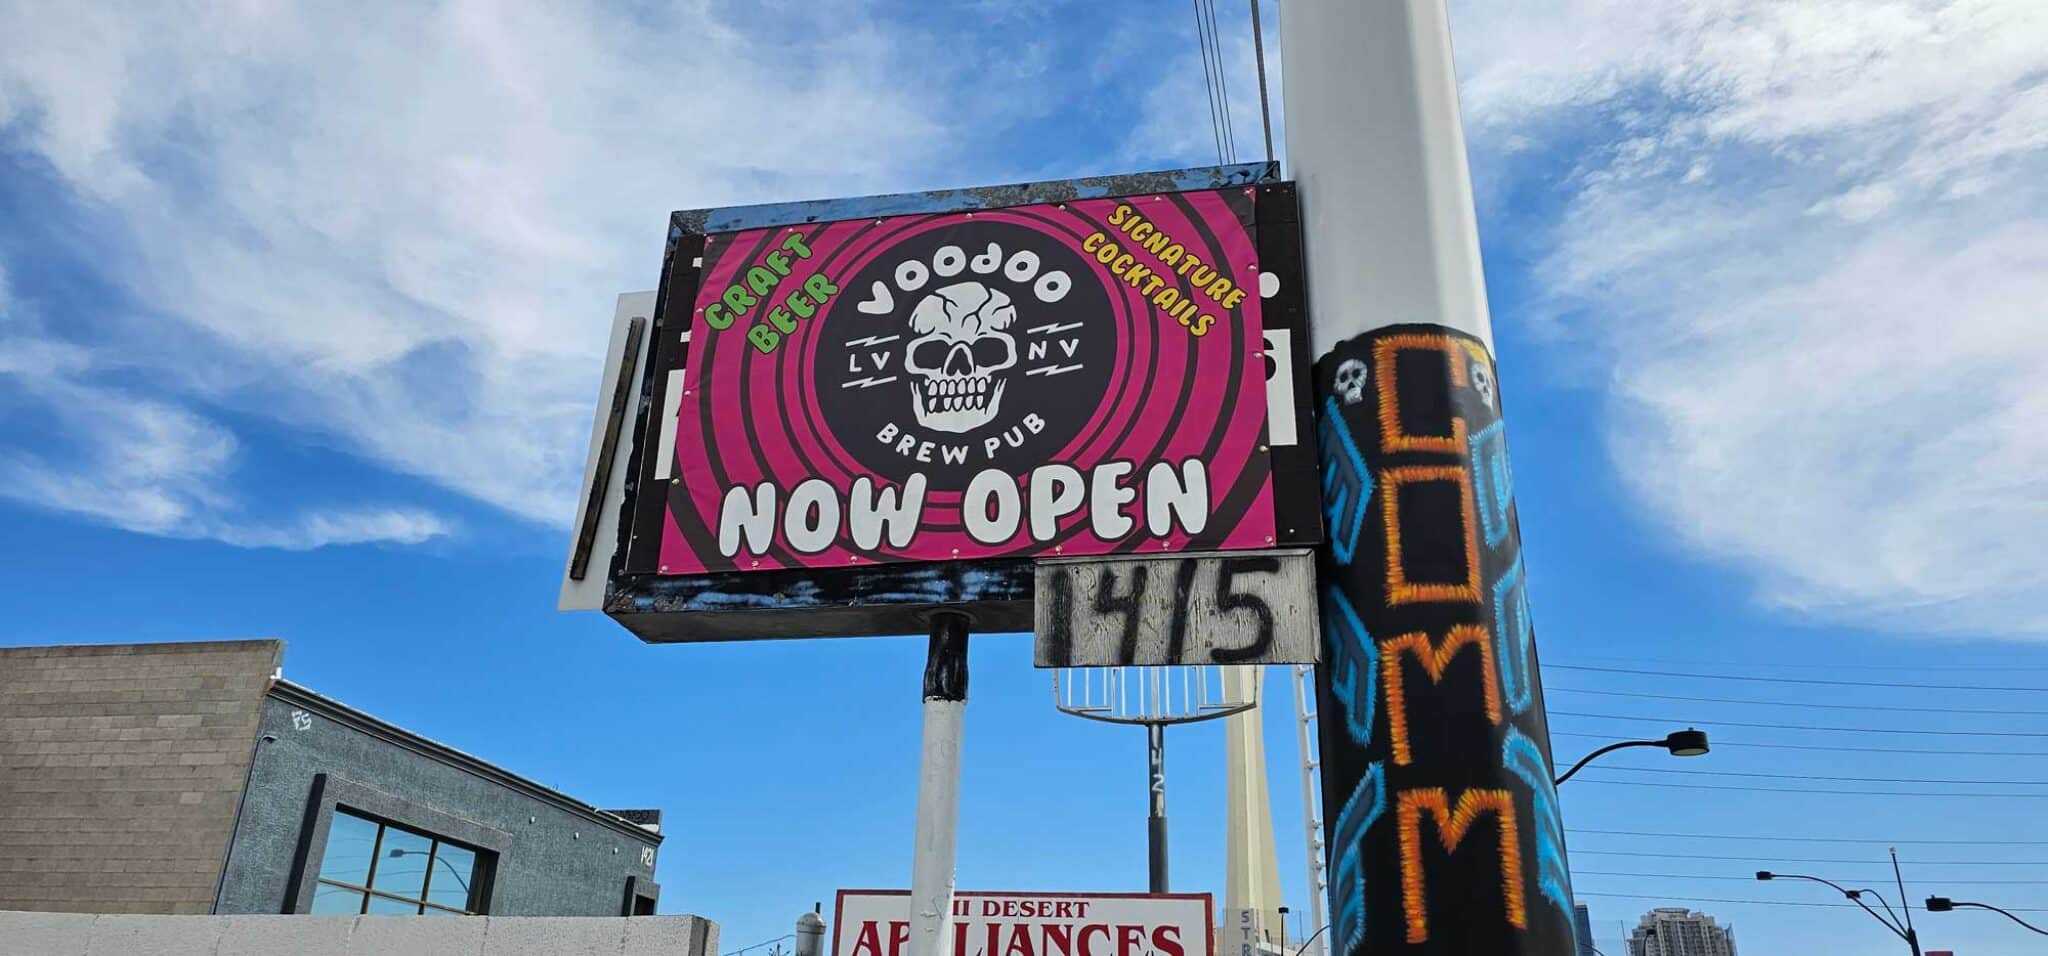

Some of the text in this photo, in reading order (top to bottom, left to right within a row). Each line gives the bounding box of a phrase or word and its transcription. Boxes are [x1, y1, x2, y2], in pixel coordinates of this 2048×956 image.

[705, 232, 812, 330] CRAFT
[1082, 232, 1216, 337] COCKTAILS
[1108, 204, 1247, 310] SIGNATURE
[747, 273, 838, 354] BEER
[876, 413, 1046, 465] BREW PUB
[718, 458, 1208, 558] NOW OPEN
[1048, 557, 1280, 664] 1415
[851, 920, 1185, 956] APLIANCES
[982, 900, 1090, 918] DESERT
